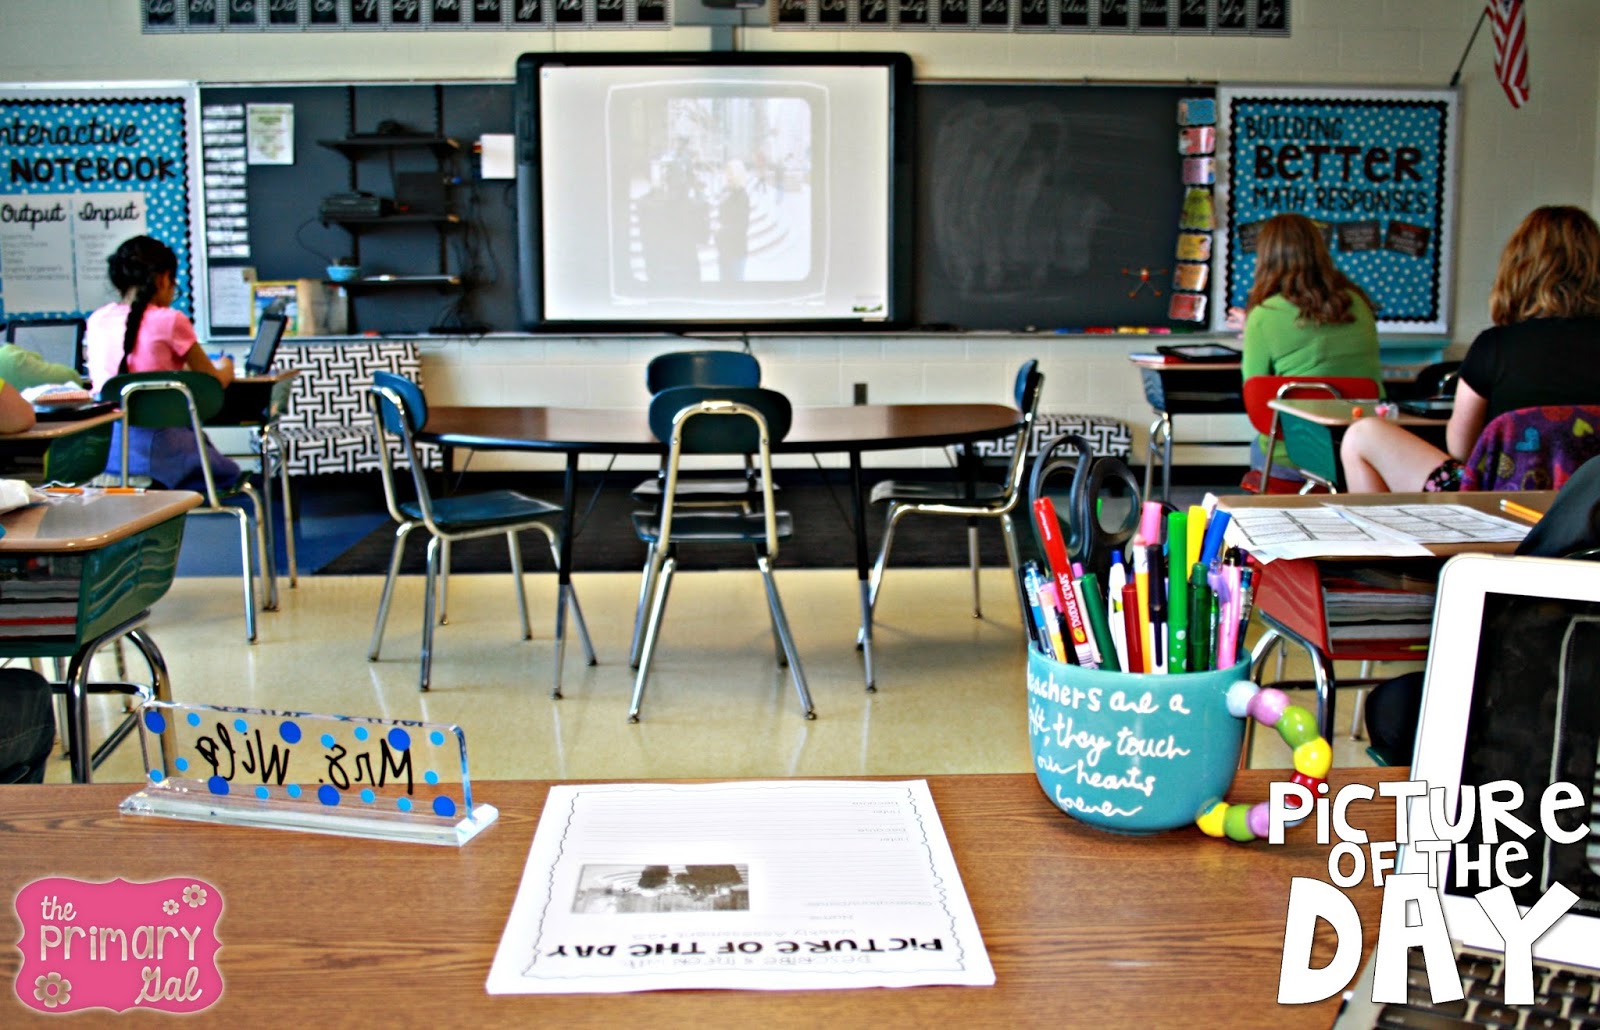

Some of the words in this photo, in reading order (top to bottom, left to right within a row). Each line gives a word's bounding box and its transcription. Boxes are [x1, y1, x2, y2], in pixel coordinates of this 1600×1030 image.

[1246, 116, 1343, 139] BUILDING
[1253, 187, 1307, 210] MATH
[1316, 188, 1428, 214] RESPONSES
[1, 203, 66, 231] Output
[78, 202, 140, 229] Input
[1169, 694, 1190, 714] a
[1053, 712, 1111, 767] they
[1116, 726, 1190, 759] touch
[1076, 759, 1156, 796] hearts
[546, 944, 617, 957] DAY
[718, 941, 764, 955] OF
